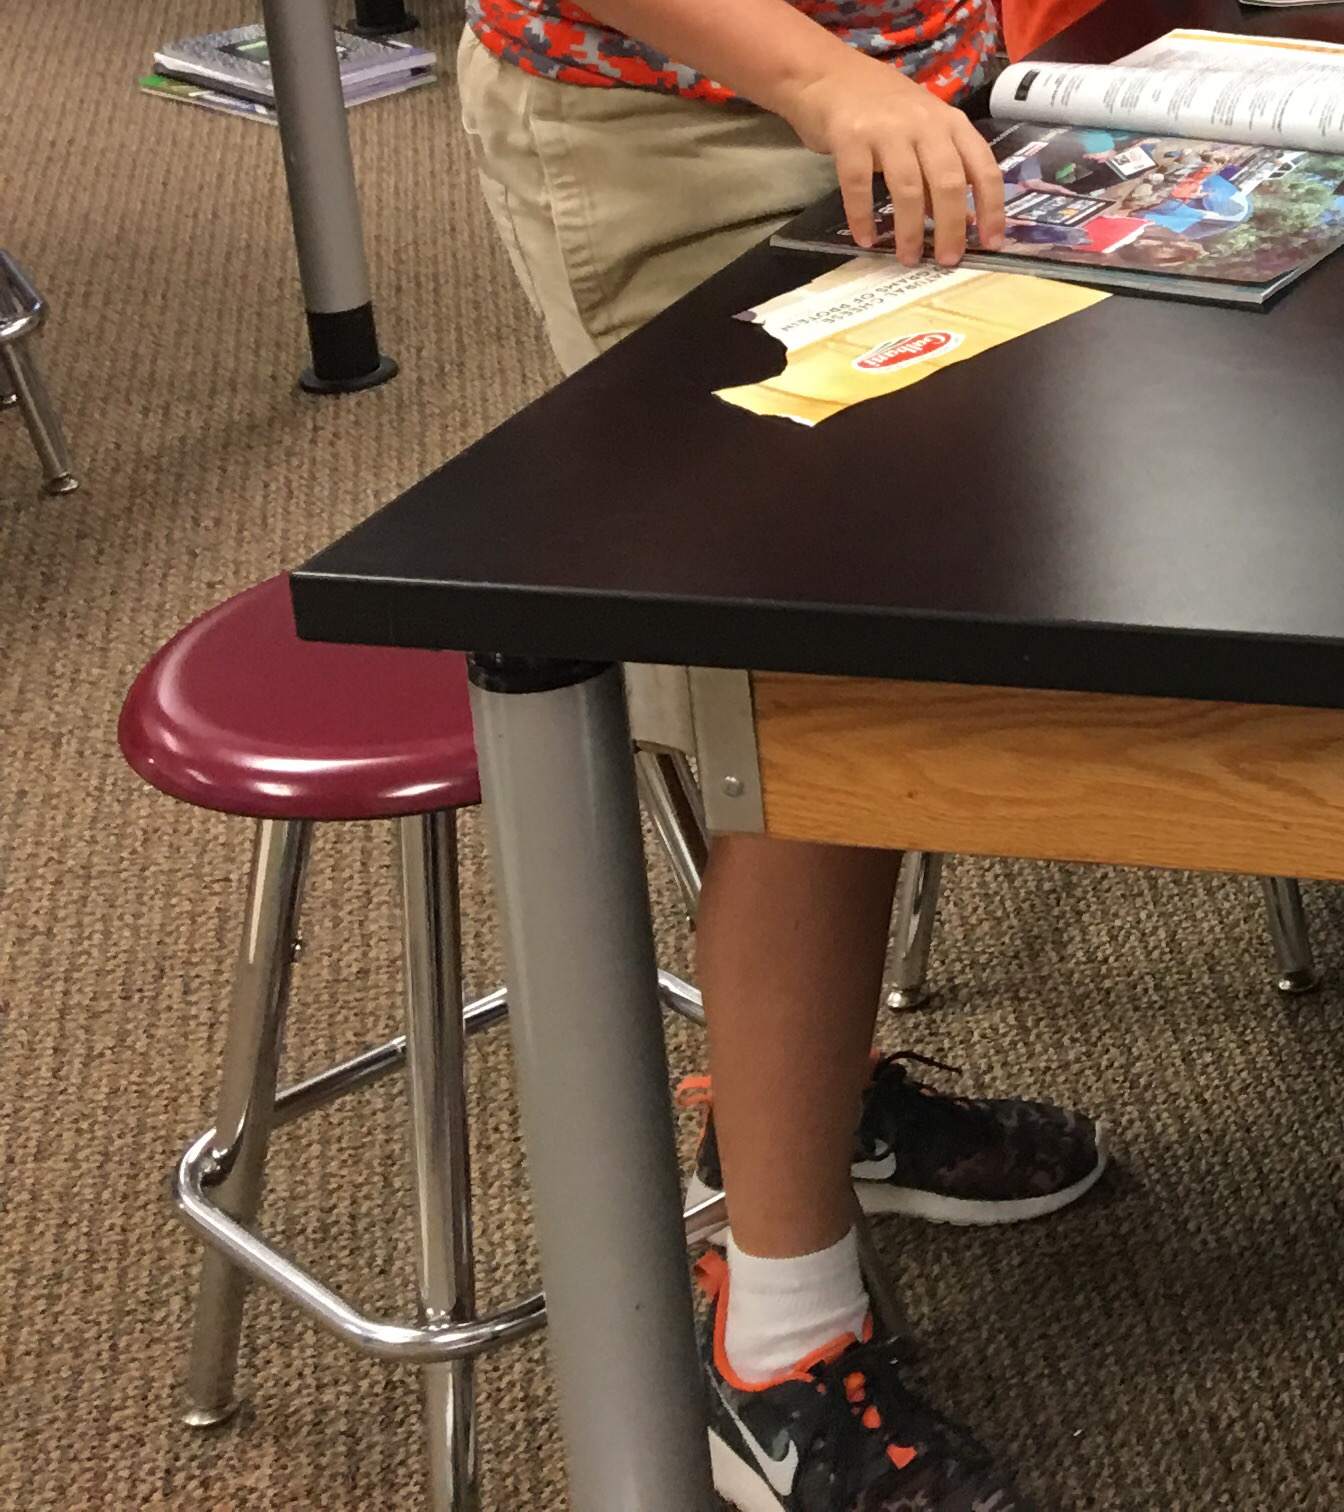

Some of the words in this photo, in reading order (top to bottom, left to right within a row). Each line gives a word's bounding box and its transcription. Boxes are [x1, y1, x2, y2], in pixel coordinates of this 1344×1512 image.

[875, 270, 930, 294] GRAMS
[822, 297, 885, 324] CHEESE
[853, 291, 875, 304] OF
[781, 301, 851, 332] PROTEIN
[864, 333, 946, 368] Galbani
